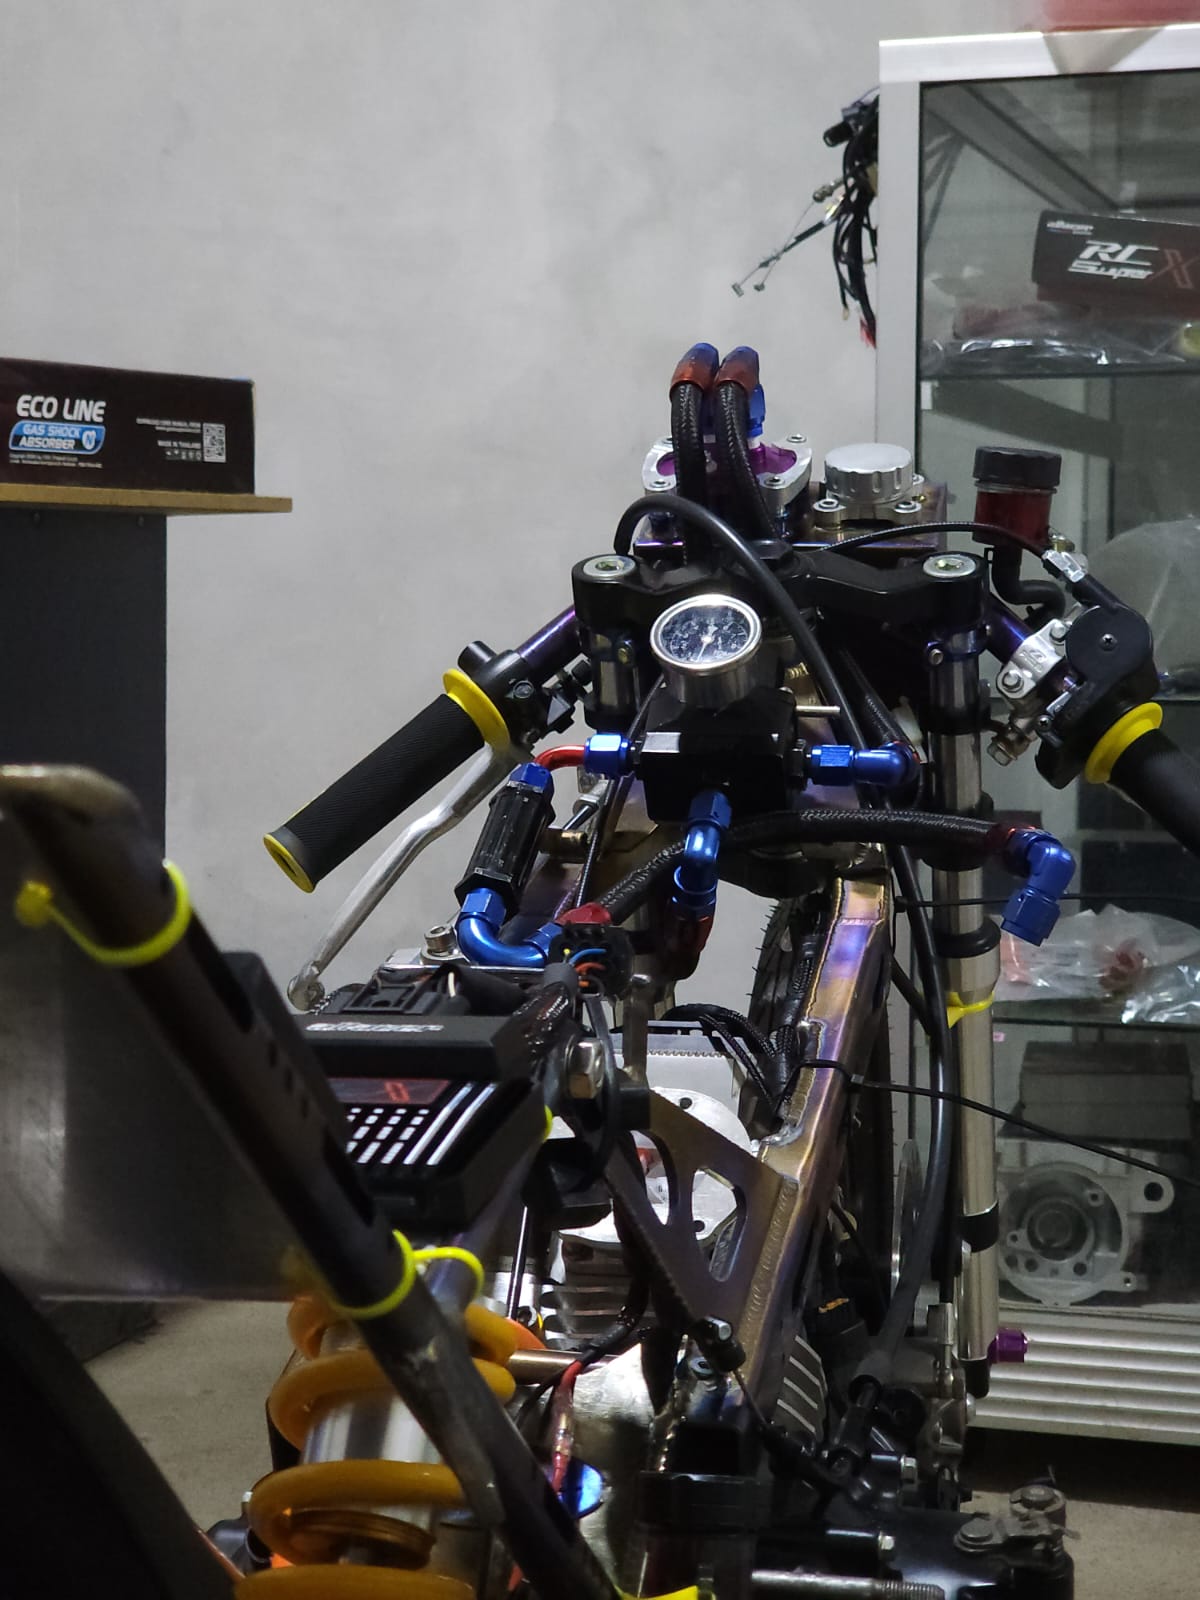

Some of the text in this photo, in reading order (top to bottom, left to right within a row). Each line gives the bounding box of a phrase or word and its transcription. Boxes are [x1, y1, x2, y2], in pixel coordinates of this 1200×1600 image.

[1067, 260, 1154, 279] Super
[16, 394, 58, 419] ECO
[62, 397, 106, 423] LINE
[22, 423, 81, 439] GAS SHOCK
[18, 435, 76, 450] ABSORBER
